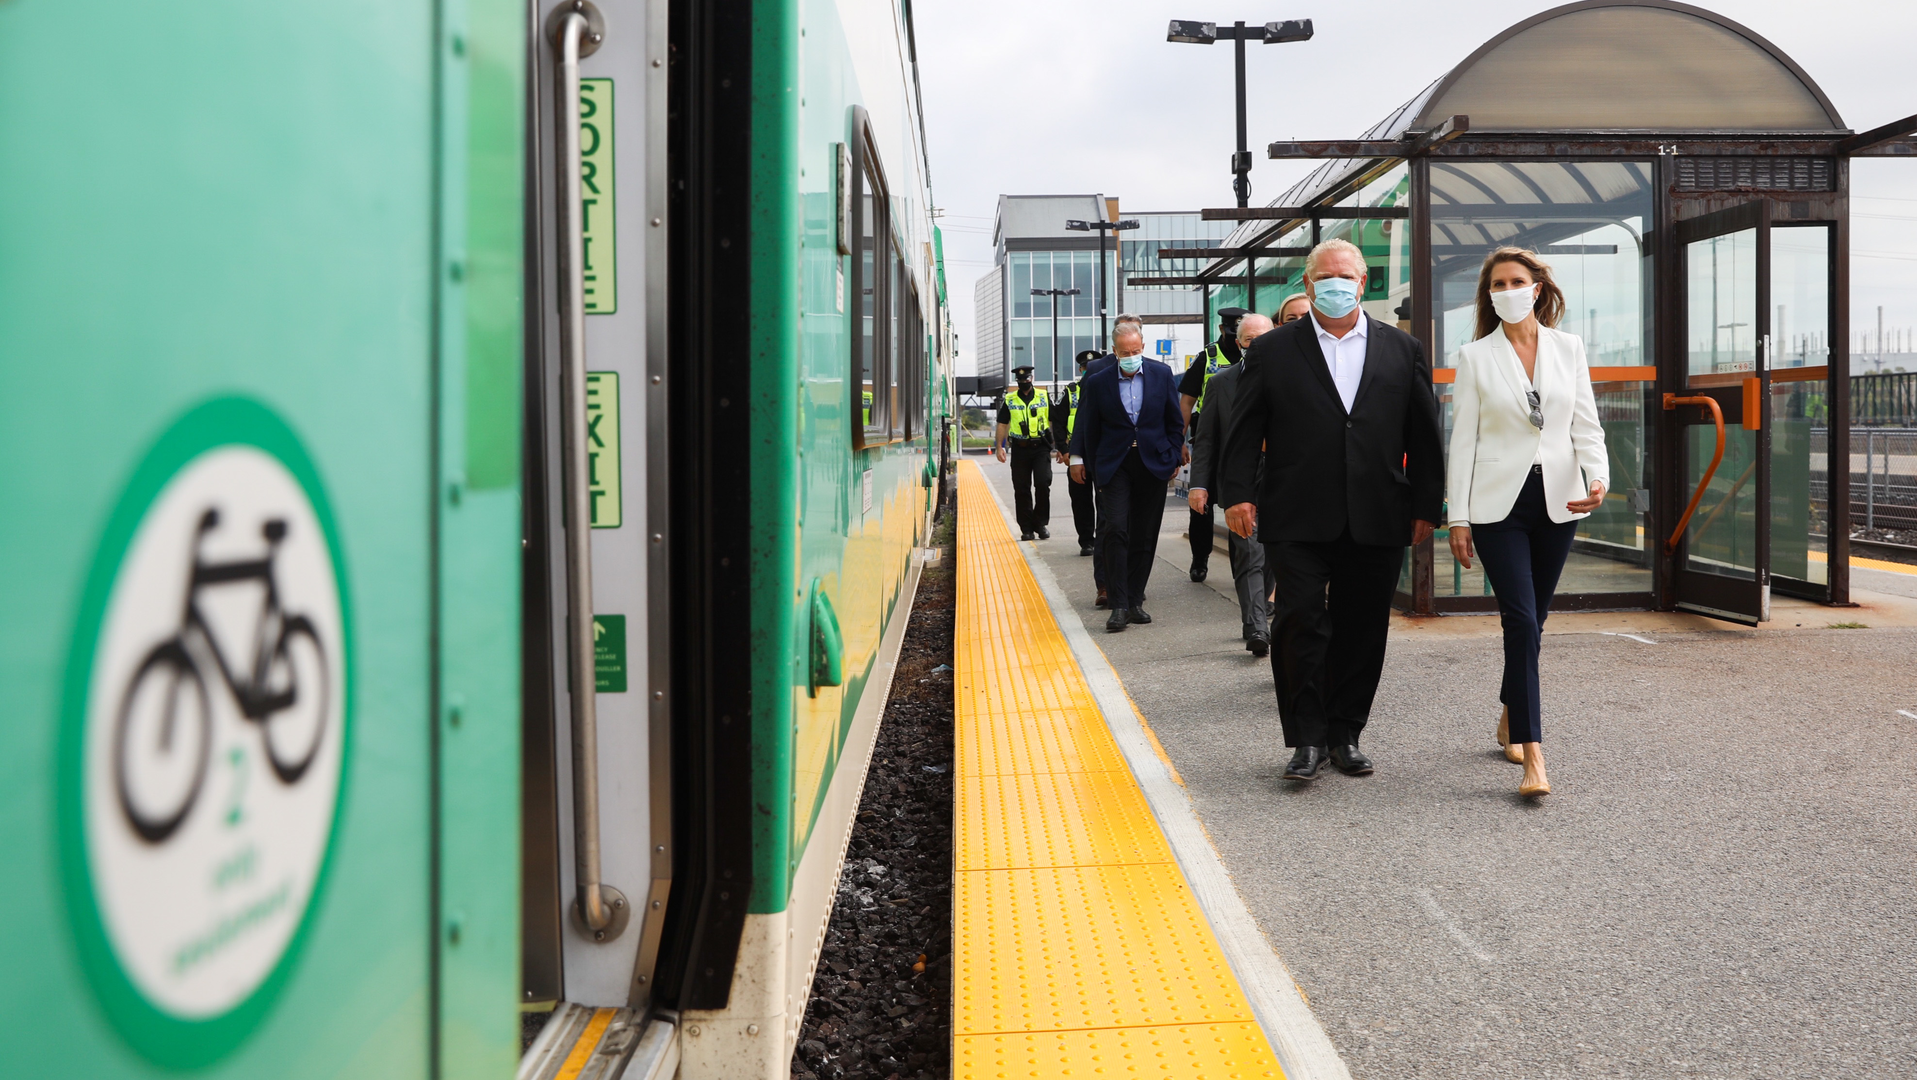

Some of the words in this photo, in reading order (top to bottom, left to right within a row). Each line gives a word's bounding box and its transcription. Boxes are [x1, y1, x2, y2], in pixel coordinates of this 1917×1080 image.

[1658, 145, 1679, 156] 1-1
[580, 84, 601, 309] SORTIE
[1160, 341, 1169, 354] L
[586, 376, 606, 523] EXIT
